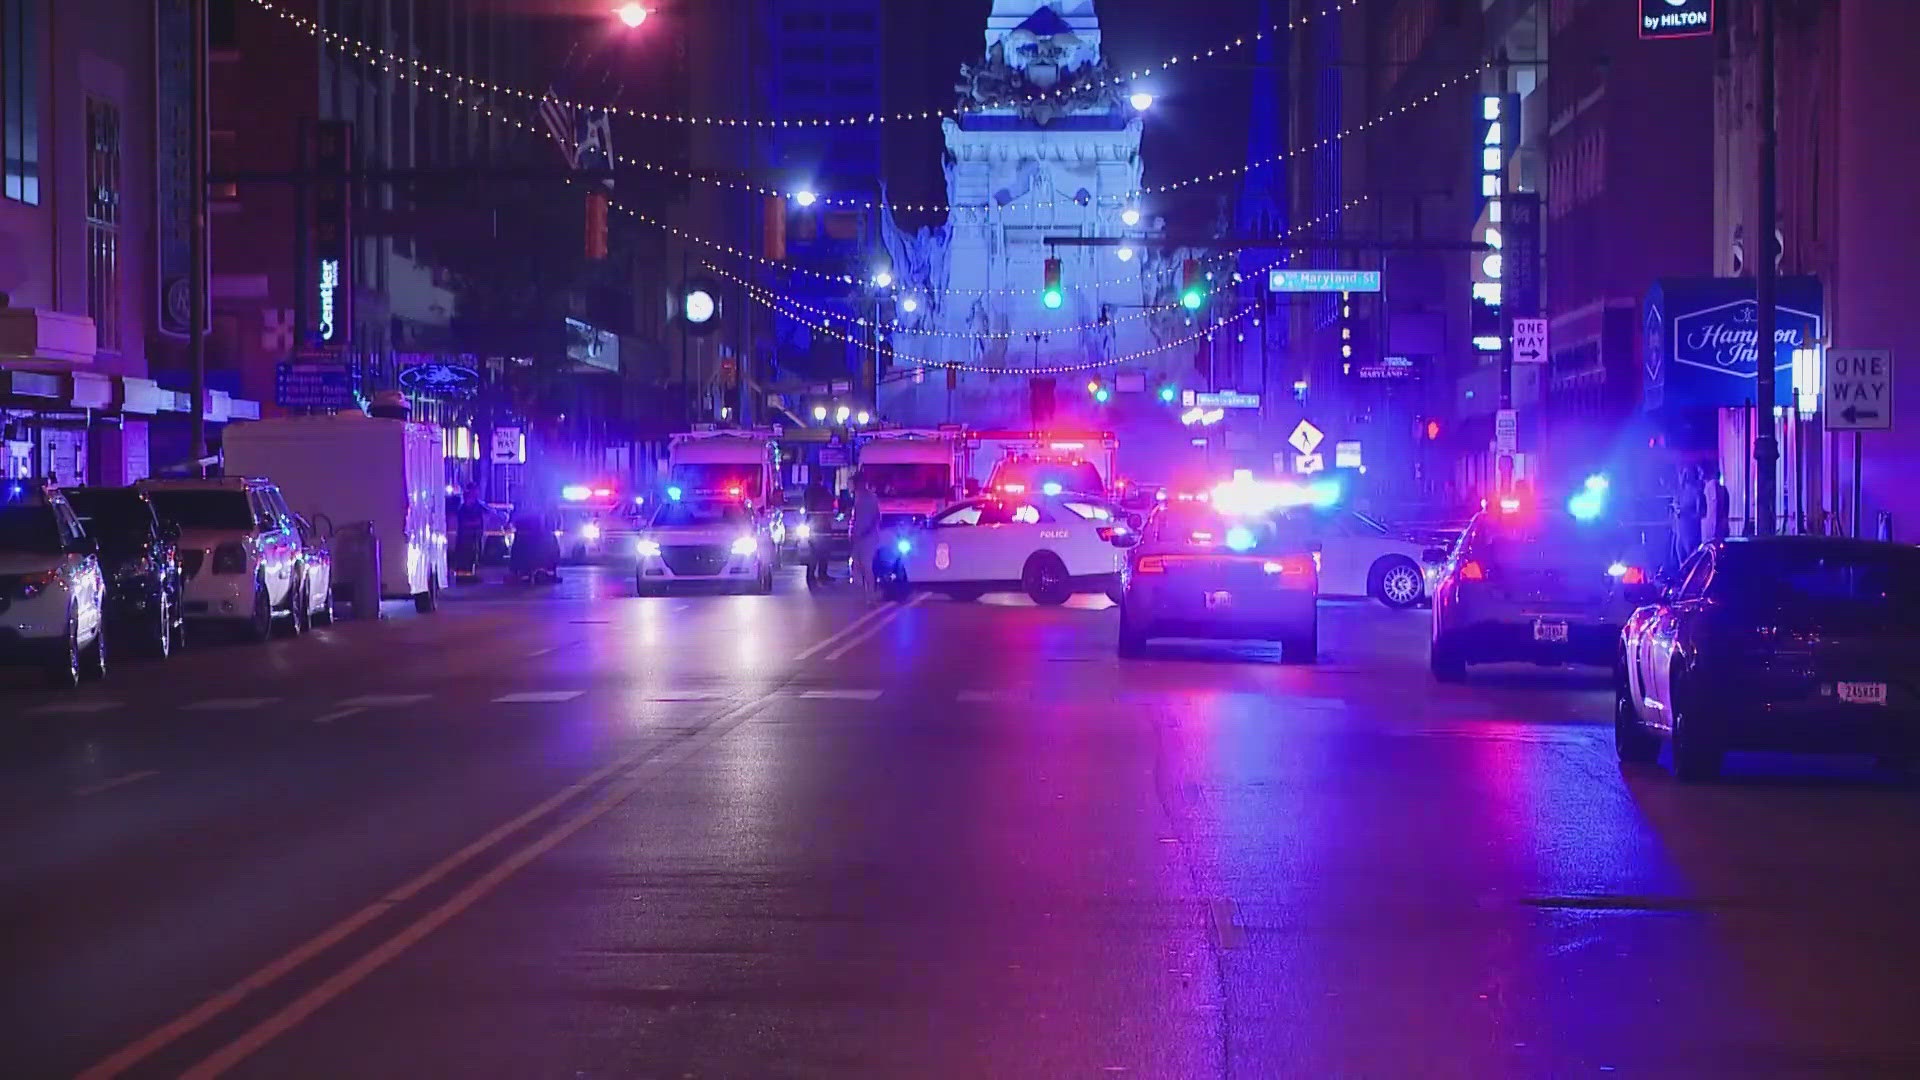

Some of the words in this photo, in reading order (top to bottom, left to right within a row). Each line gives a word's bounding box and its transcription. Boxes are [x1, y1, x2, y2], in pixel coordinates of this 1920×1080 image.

[1644, 15, 1659, 30] by
[1661, 11, 1707, 27] HILTON
[1301, 271, 1357, 286] Maryland
[1363, 271, 1375, 283] St
[1517, 322, 1544, 334] ONE
[1687, 323, 1804, 350] Hamon
[1516, 336, 1545, 348] WAY
[1835, 356, 1884, 376] ONE
[1833, 382, 1886, 401] WAY
[1040, 530, 1069, 538] POLICE
